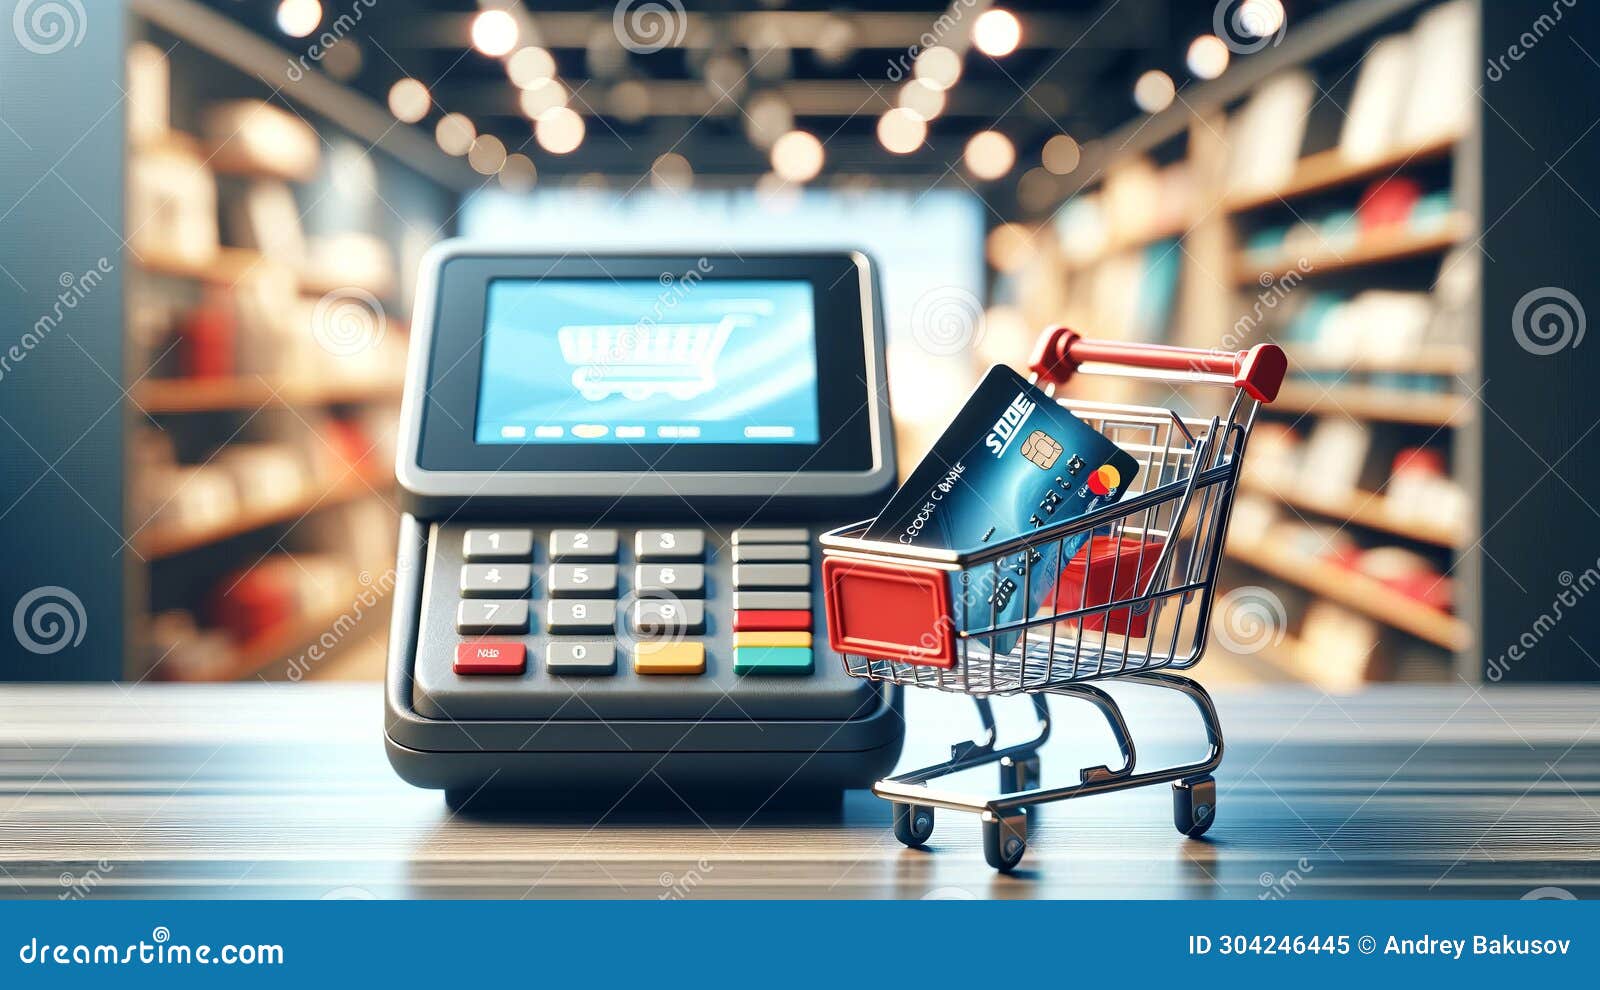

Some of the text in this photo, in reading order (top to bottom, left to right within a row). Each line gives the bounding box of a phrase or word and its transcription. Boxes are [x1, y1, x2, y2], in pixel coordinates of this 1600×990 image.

[487, 533, 500, 549] 1
[573, 533, 589, 549] 2
[659, 533, 676, 549] 3
[484, 568, 502, 584] 4
[572, 568, 589, 584] 5
[659, 568, 676, 584] 6
[483, 604, 500, 620] 7
[660, 604, 676, 619] 9
